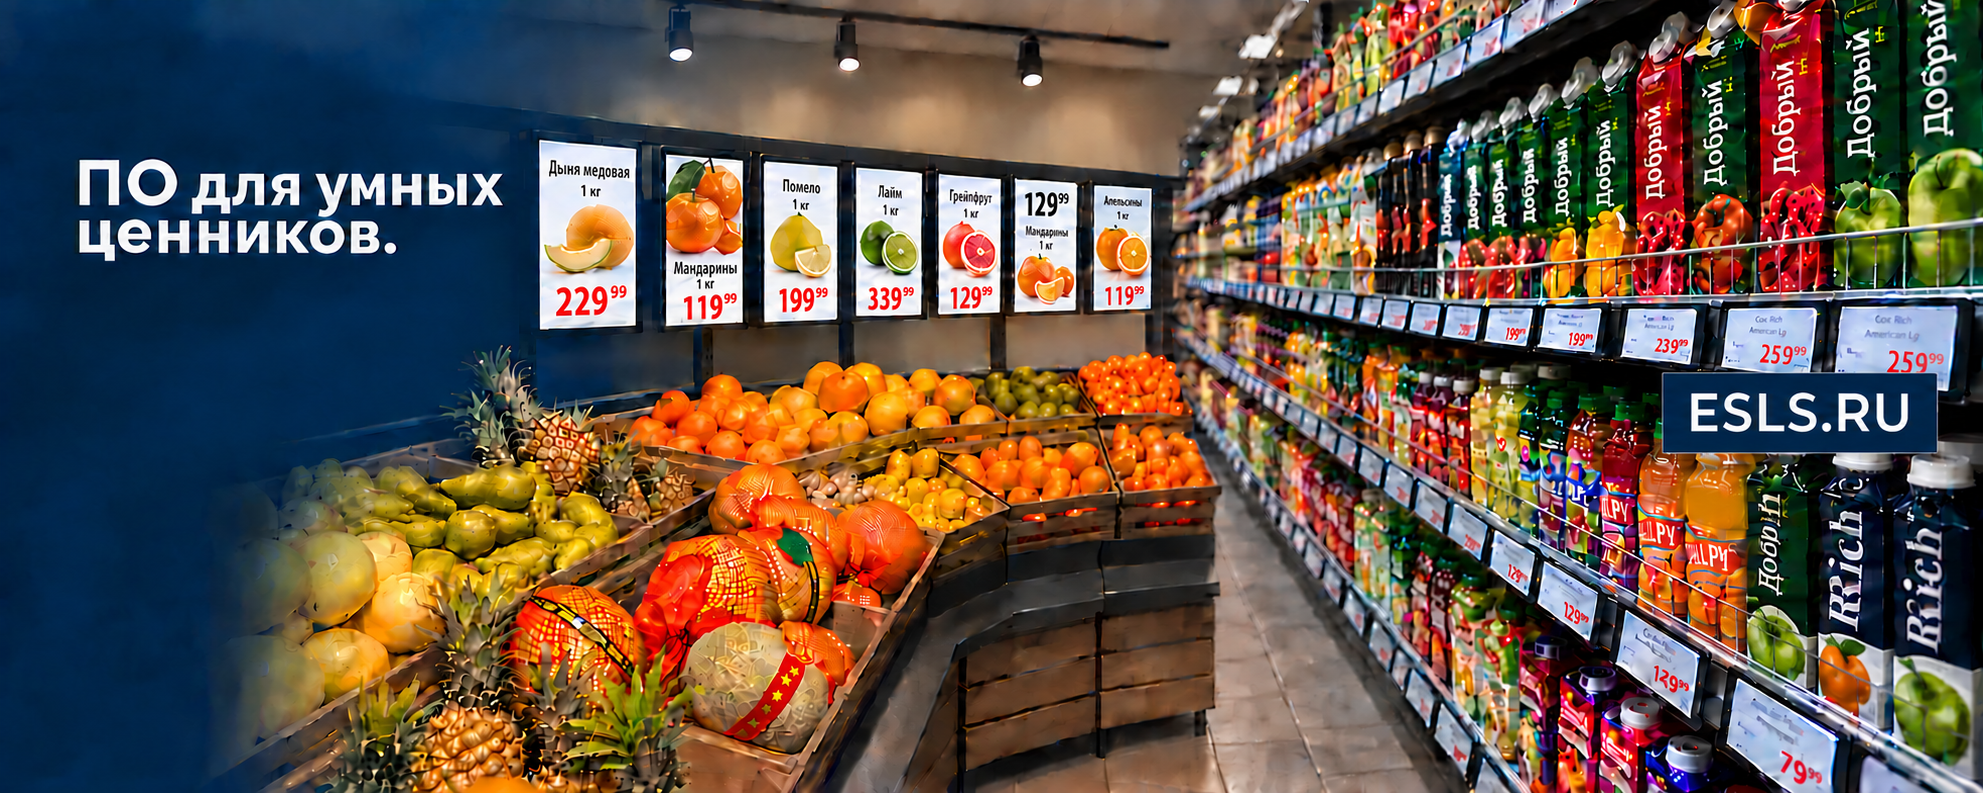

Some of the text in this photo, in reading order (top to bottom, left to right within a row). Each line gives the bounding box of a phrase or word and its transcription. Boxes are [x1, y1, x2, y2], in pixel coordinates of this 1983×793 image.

[1845, 28, 1877, 158] Добрый
[1770, 60, 1801, 176] Добрый
[1701, 80, 1728, 186] Добрый
[1644, 105, 1667, 200] Добрый
[548, 160, 630, 180] Дыня медовая
[1596, 120, 1615, 207] Добрый
[1521, 148, 1539, 223] Добрый
[1554, 137, 1572, 217] Добрый
[581, 185, 601, 198] 1 кг
[782, 179, 821, 195] Помело
[878, 185, 902, 199] Лайм
[793, 199, 810, 211] 1 кг
[950, 189, 992, 206] Грейпфрут
[883, 205, 899, 217] 1 кг
[963, 208, 968, 218] 1
[1117, 211, 1121, 219] 1
[1039, 241, 1043, 250] 1
[674, 261, 737, 278] Мандарины
[696, 279, 714, 290] 1 кг
